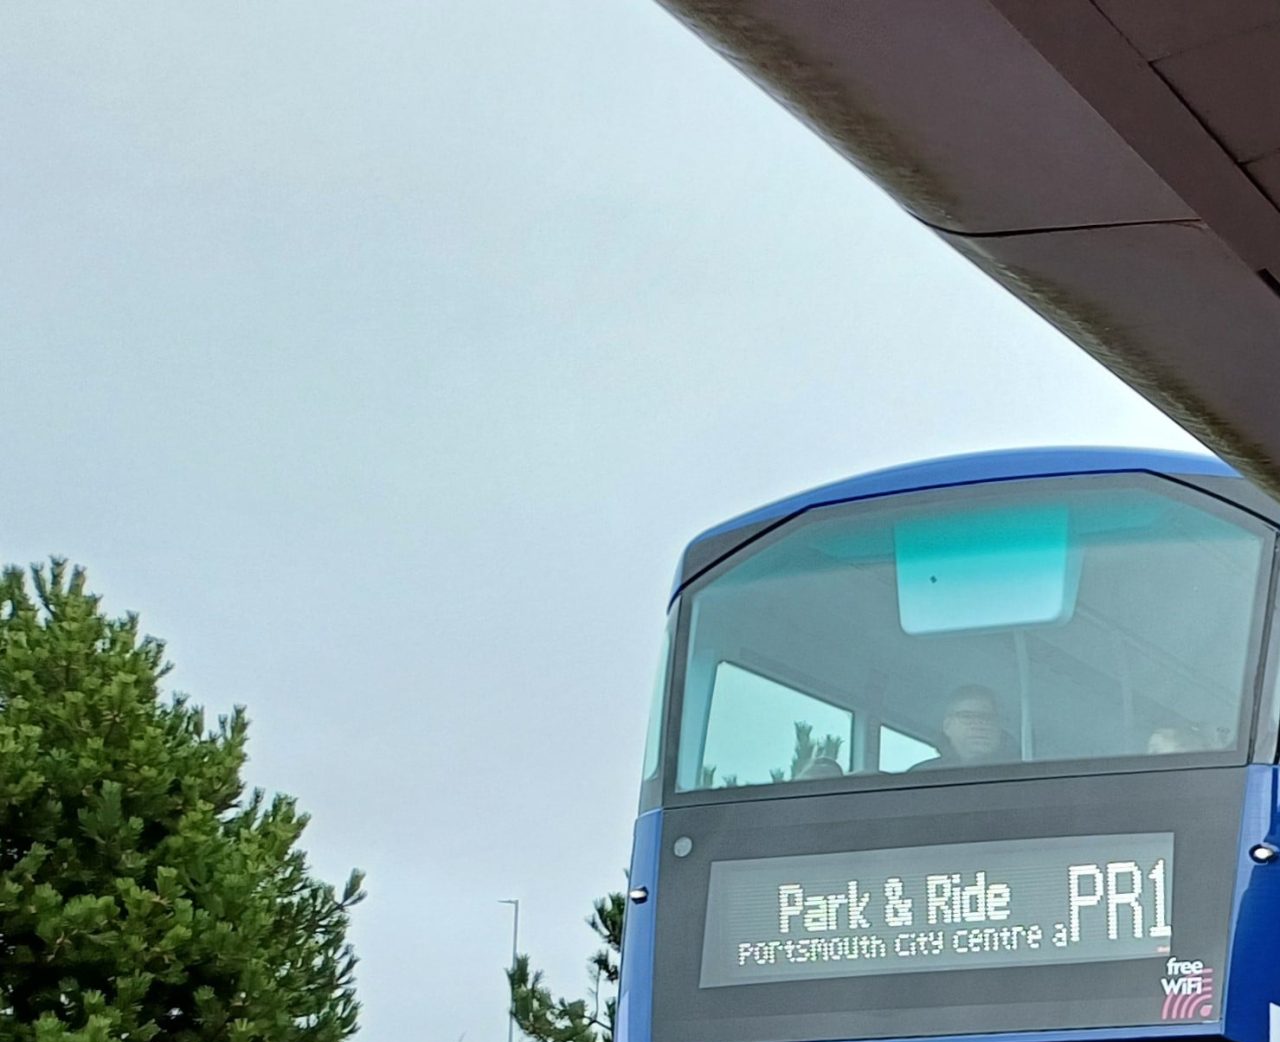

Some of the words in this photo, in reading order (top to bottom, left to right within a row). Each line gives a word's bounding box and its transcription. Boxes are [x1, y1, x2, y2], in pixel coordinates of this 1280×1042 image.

[779, 880, 871, 933] Park
[884, 877, 913, 927] &
[926, 871, 1010, 925] Ride
[1068, 858, 1172, 942] PR1
[1161, 977, 1202, 995] WiFi
[1166, 957, 1204, 975] free
